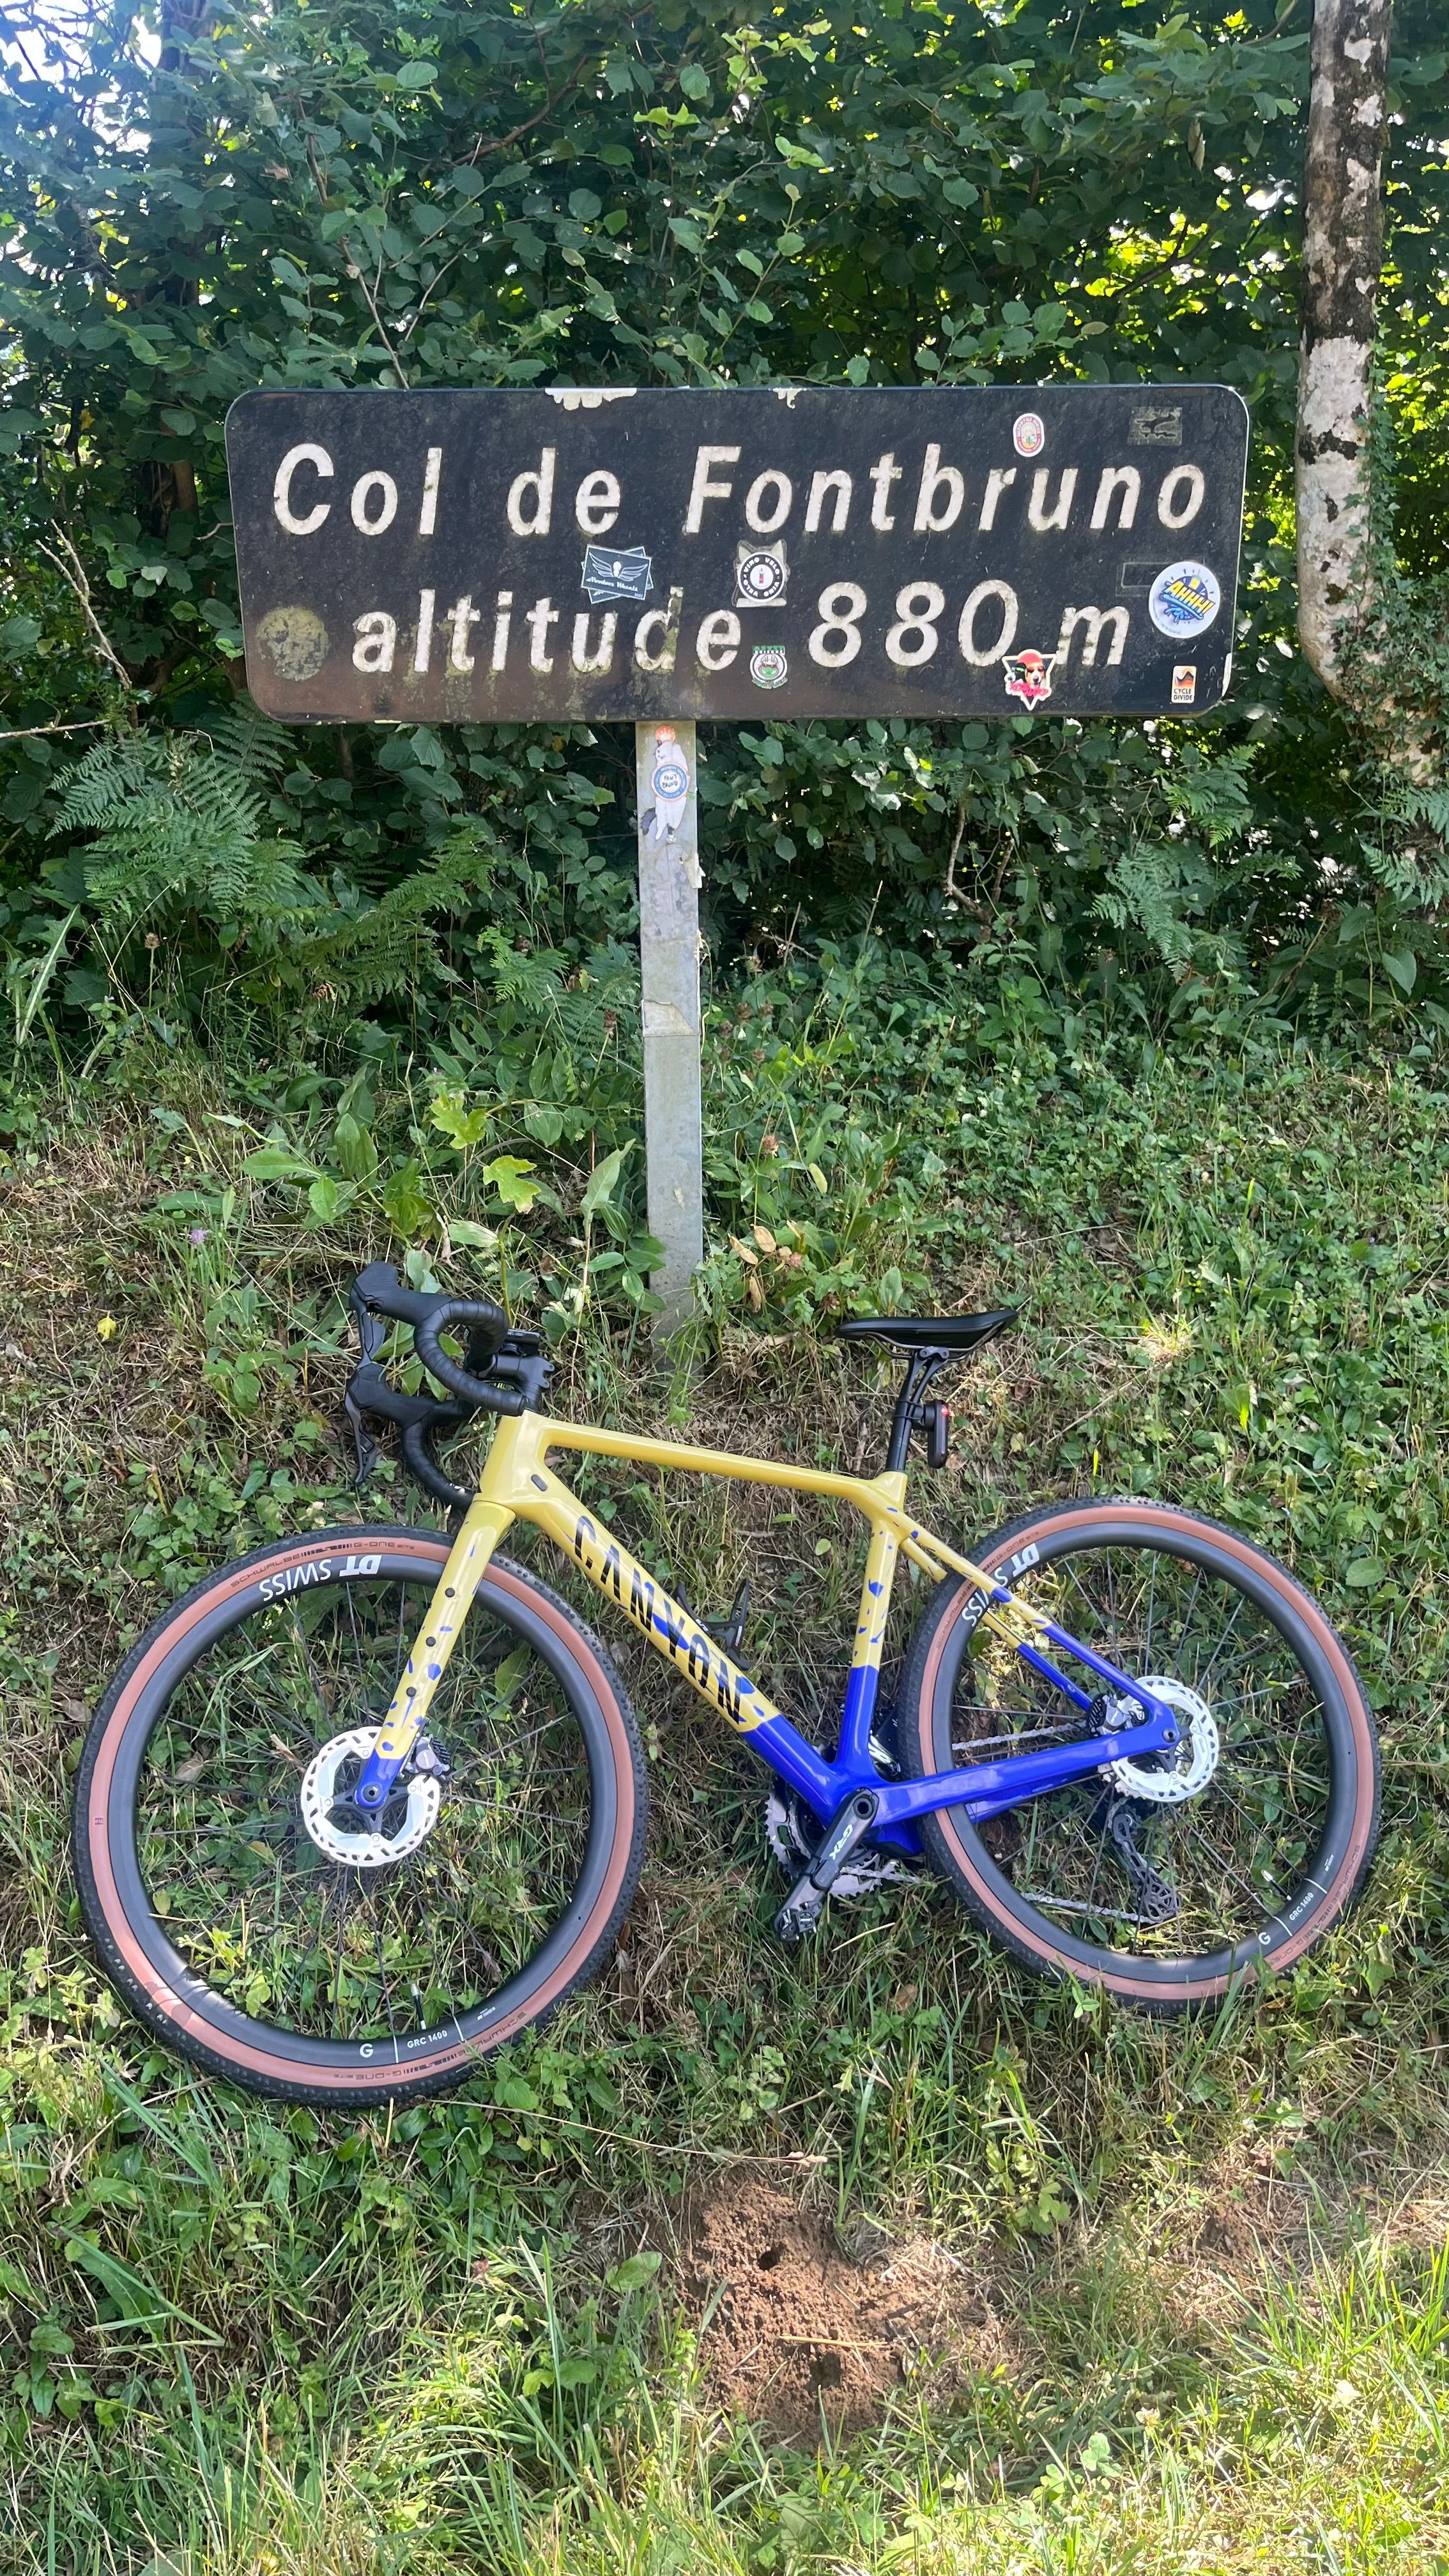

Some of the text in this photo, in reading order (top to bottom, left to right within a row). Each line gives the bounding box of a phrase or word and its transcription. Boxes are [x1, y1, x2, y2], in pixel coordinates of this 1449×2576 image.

[273, 443, 1206, 535] Col de Fontbruno
[743, 556, 780, 574] VINO VELO
[351, 586, 741, 673] altitude
[807, 579, 1019, 668] 880
[1054, 604, 1130, 666] m
[231, 1552, 301, 1588] SCHWALBE
[1011, 1543, 1040, 1577] DT
[259, 1554, 382, 1602] DT SWISS
[574, 1515, 744, 1725] CANYON
[1289, 1892, 1314, 1921] GRC 1400
[1259, 1932, 1271, 1945] G
[359, 2043, 374, 2058] G
[407, 2030, 448, 2049] GRC 1400
